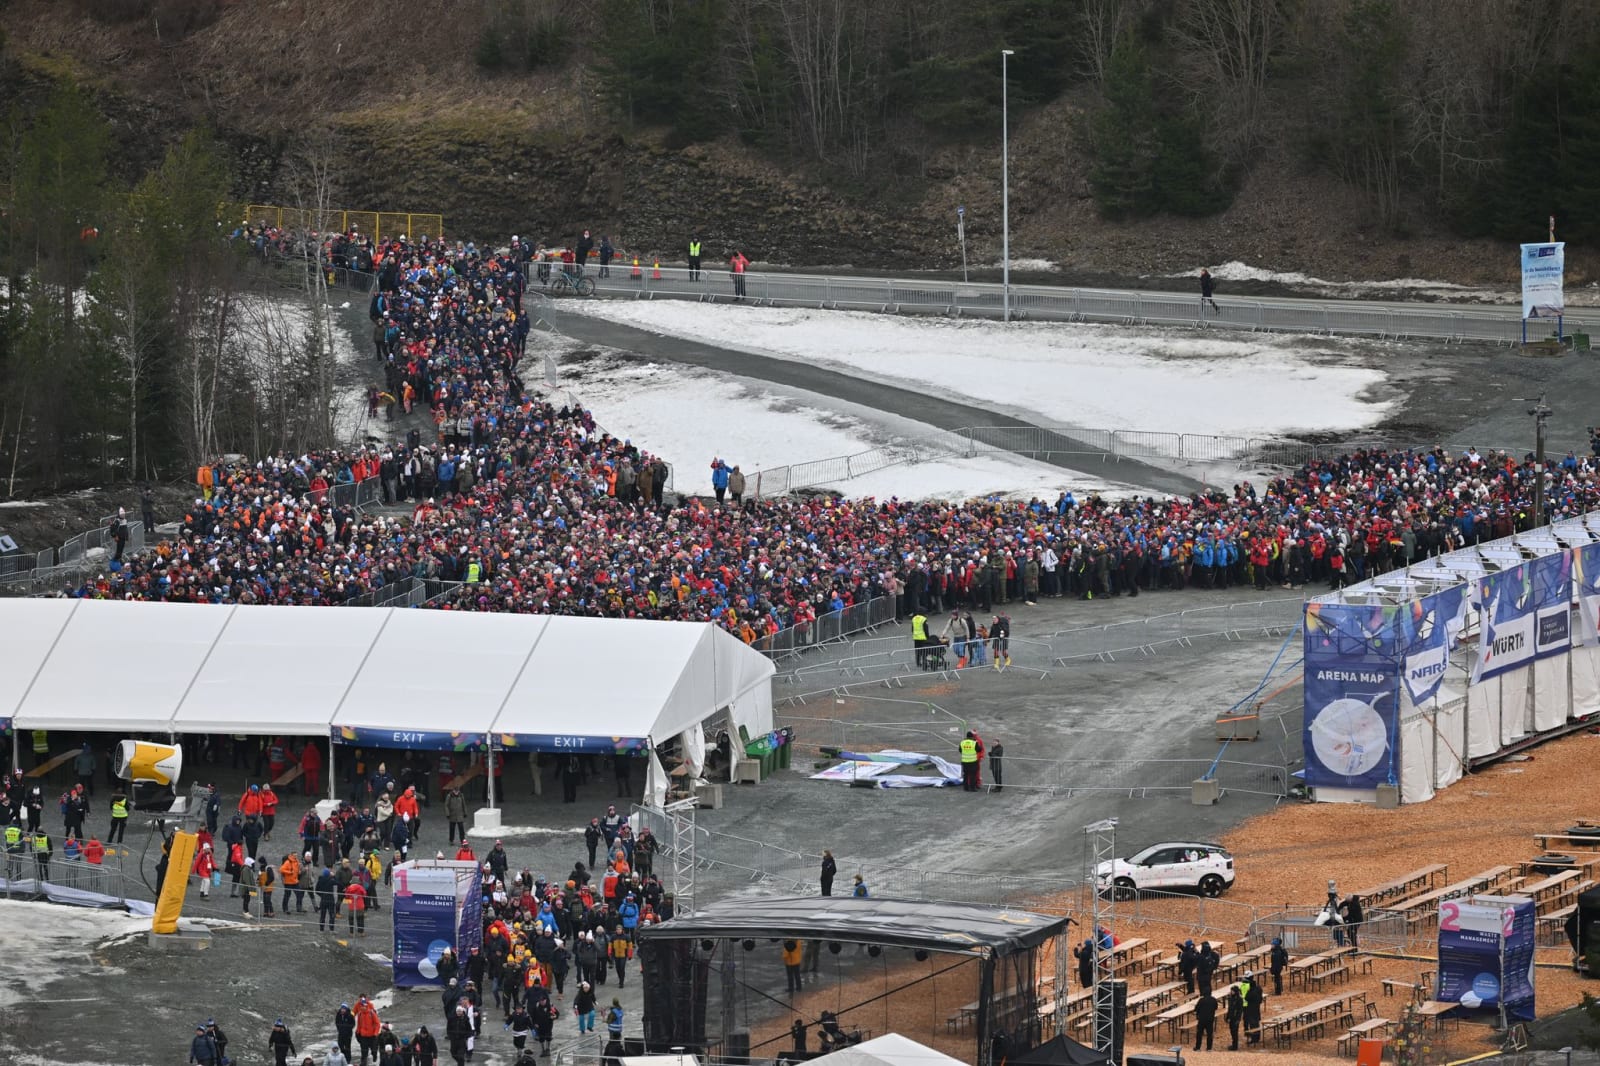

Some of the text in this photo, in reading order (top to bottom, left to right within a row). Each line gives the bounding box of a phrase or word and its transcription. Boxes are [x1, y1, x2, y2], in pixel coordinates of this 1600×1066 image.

[1492, 630, 1525, 657] WÜRTH
[1317, 670, 1385, 684] ARENA MAP
[393, 732, 425, 744] EXIT
[554, 737, 586, 748] EXIT
[395, 869, 413, 897] 1
[1440, 902, 1461, 932] 2
[1503, 908, 1515, 938] 2
[1460, 935, 1498, 944] MANAGEMENT
